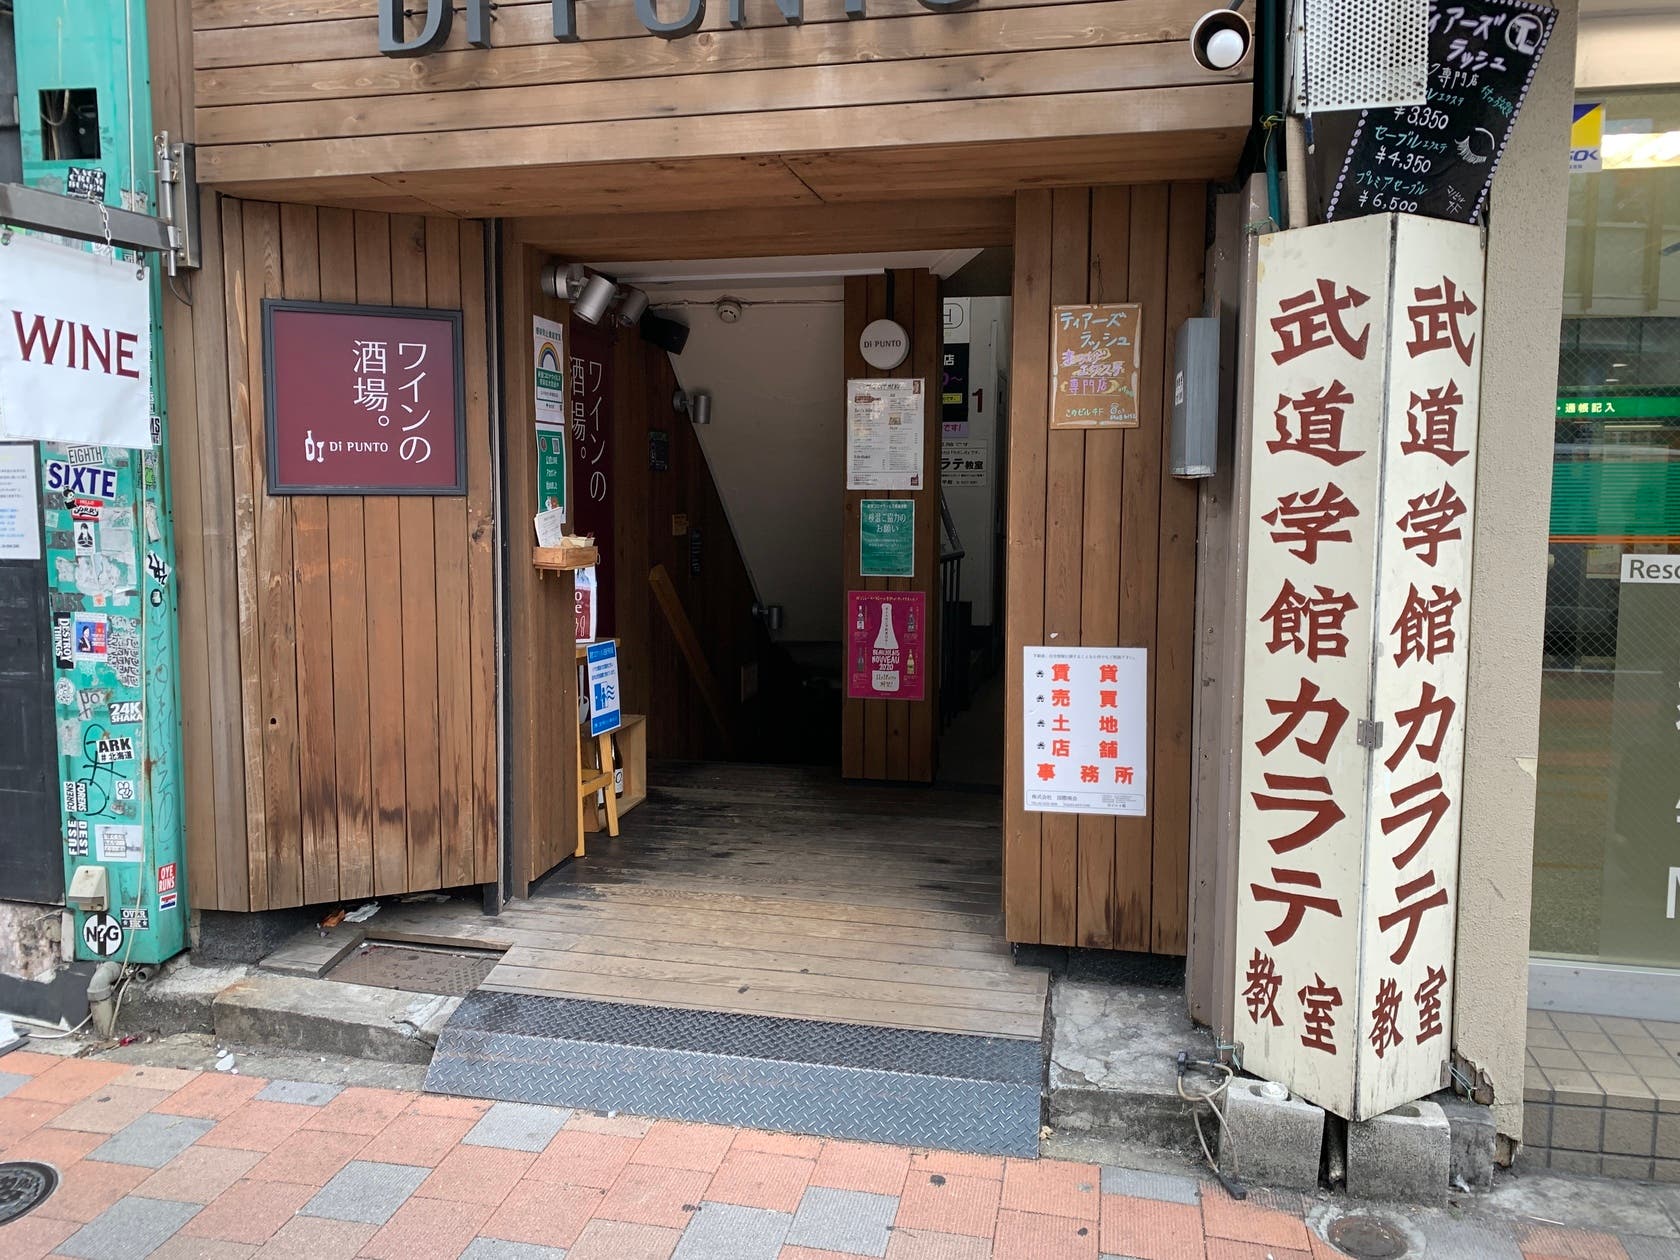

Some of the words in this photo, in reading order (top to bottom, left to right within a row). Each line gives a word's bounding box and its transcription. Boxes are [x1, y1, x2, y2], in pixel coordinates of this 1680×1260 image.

[1447, 39, 1507, 71] ラッシュ
[1375, 145, 1431, 173] ¥4,350
[1358, 190, 1418, 213] ¥6,500
[1060, 311, 1127, 330] ティアーズ
[12, 310, 140, 379] WINE
[875, 340, 902, 348] PUNTO
[1080, 330, 1130, 349] ラッシュ
[352, 340, 390, 427] 酒場。
[398, 343, 431, 463] ワインの
[972, 388, 983, 413] 1
[589, 361, 606, 501] ワインの
[69, 447, 103, 464] EIGHTH
[347, 442, 389, 453] PUNTO
[48, 463, 116, 498] SIXTE
[59, 618, 74, 663] DESTROY
[1241, 278, 1371, 1055] 武道学館カラテ教室
[1368, 275, 1477, 1059] 武道学館カラテ教室
[110, 702, 141, 716] 24K
[99, 738, 131, 753] ARK
[67, 782, 75, 811] FORENS
[68, 820, 78, 856] FUSE
